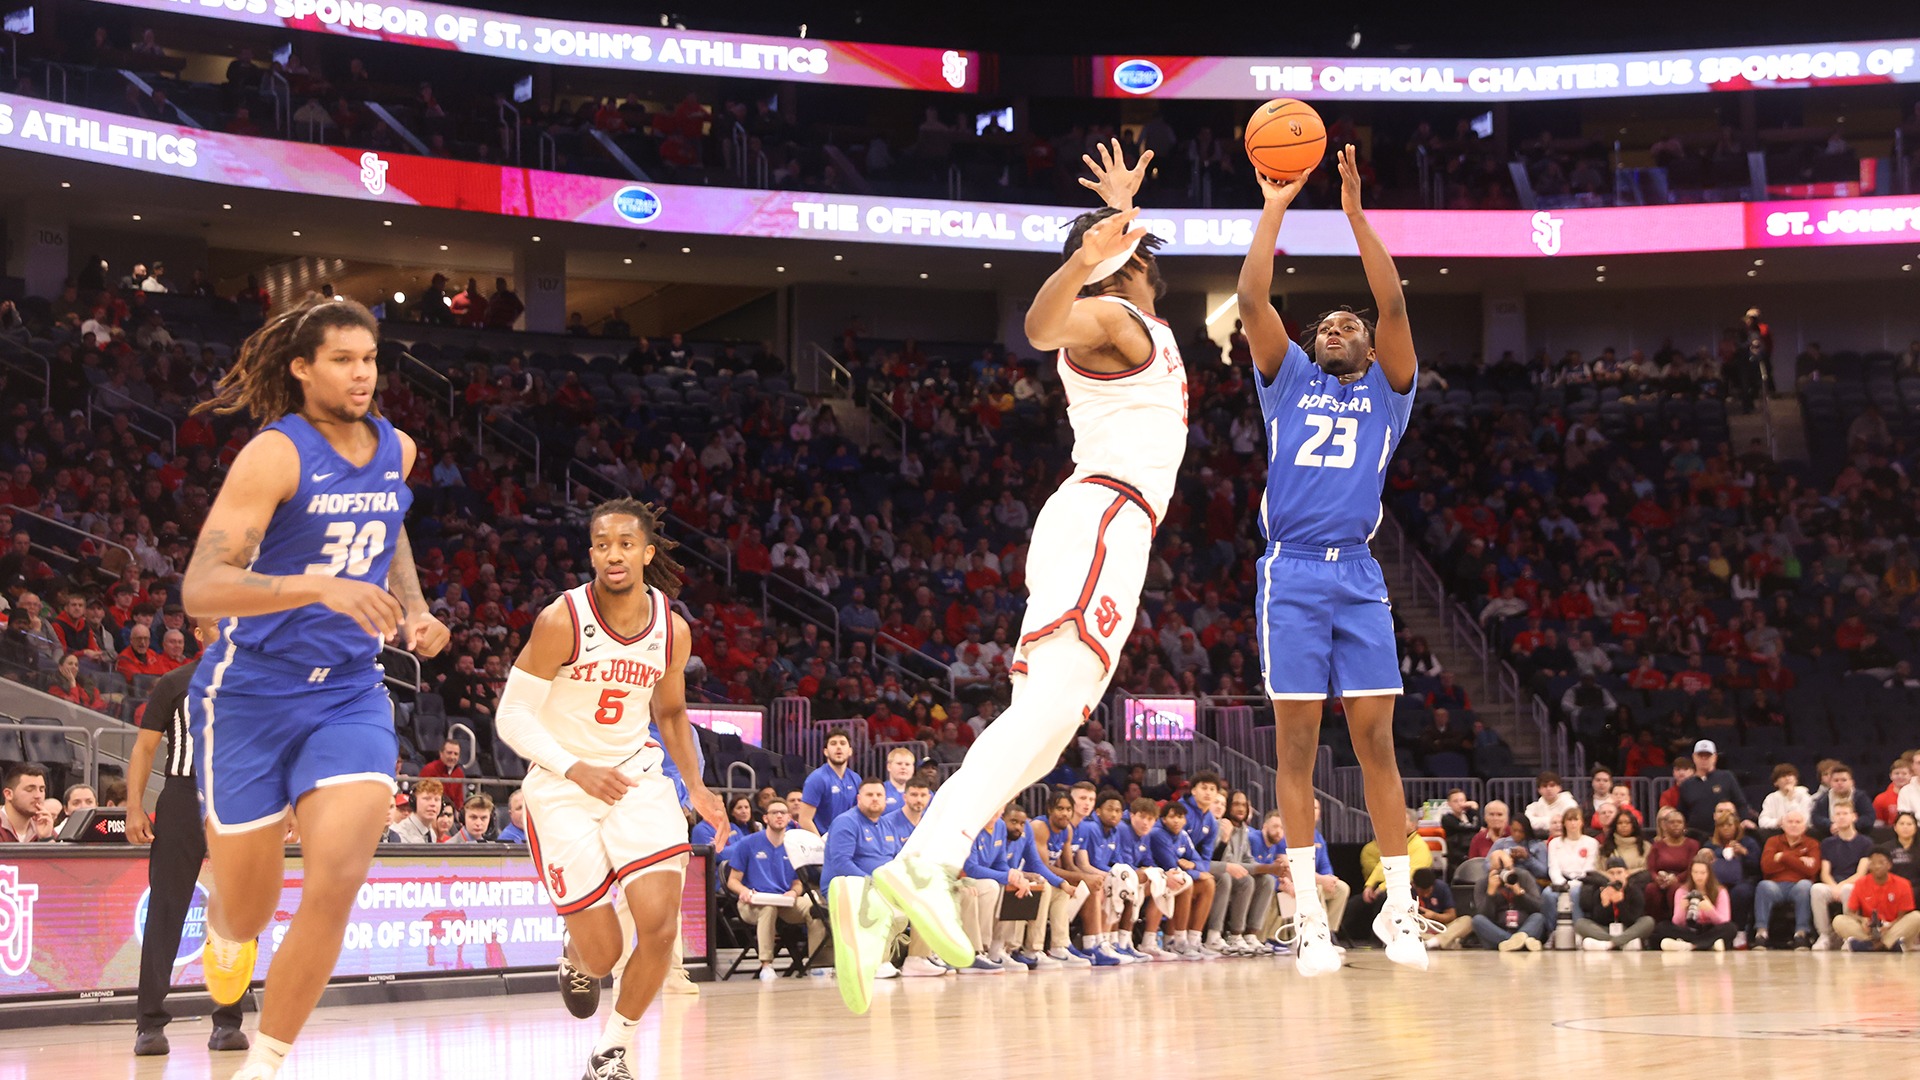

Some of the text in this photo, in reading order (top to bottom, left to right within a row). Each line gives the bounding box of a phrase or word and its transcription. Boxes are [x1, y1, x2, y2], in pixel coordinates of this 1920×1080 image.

[274, 0, 829, 74] SPONSOR OF ST. JOHN'S ATHLETICS
[1249, 48, 1915, 93] THE OFFICIAL CHARTER BUS SPONSOR OF
[20, 110, 198, 167] ATHLETICS
[40, 229, 63, 246] 106
[792, 202, 859, 232] THE
[866, 206, 1016, 241] OFFICIAL
[1184, 218, 1254, 246] BUS
[1766, 211, 1815, 236] ST.
[1296, 393, 1372, 414] HOFSTRA
[1293, 413, 1359, 469] 23
[306, 491, 400, 515] HOFSTRA
[303, 519, 387, 578] 30
[1325, 547, 1340, 562] H
[308, 667, 331, 683] H
[569, 658, 663, 689] ST. JOHN'S
[594, 688, 632, 725] 5
[107, 819, 126, 833] POSS
[356, 881, 447, 910] OFFICIAL
[449, 881, 535, 908] CHARTER
[376, 921, 406, 949] OF
[408, 920, 438, 948] ST.
[439, 917, 509, 947] JOHN'S
[510, 916, 565, 943] ATHLE
